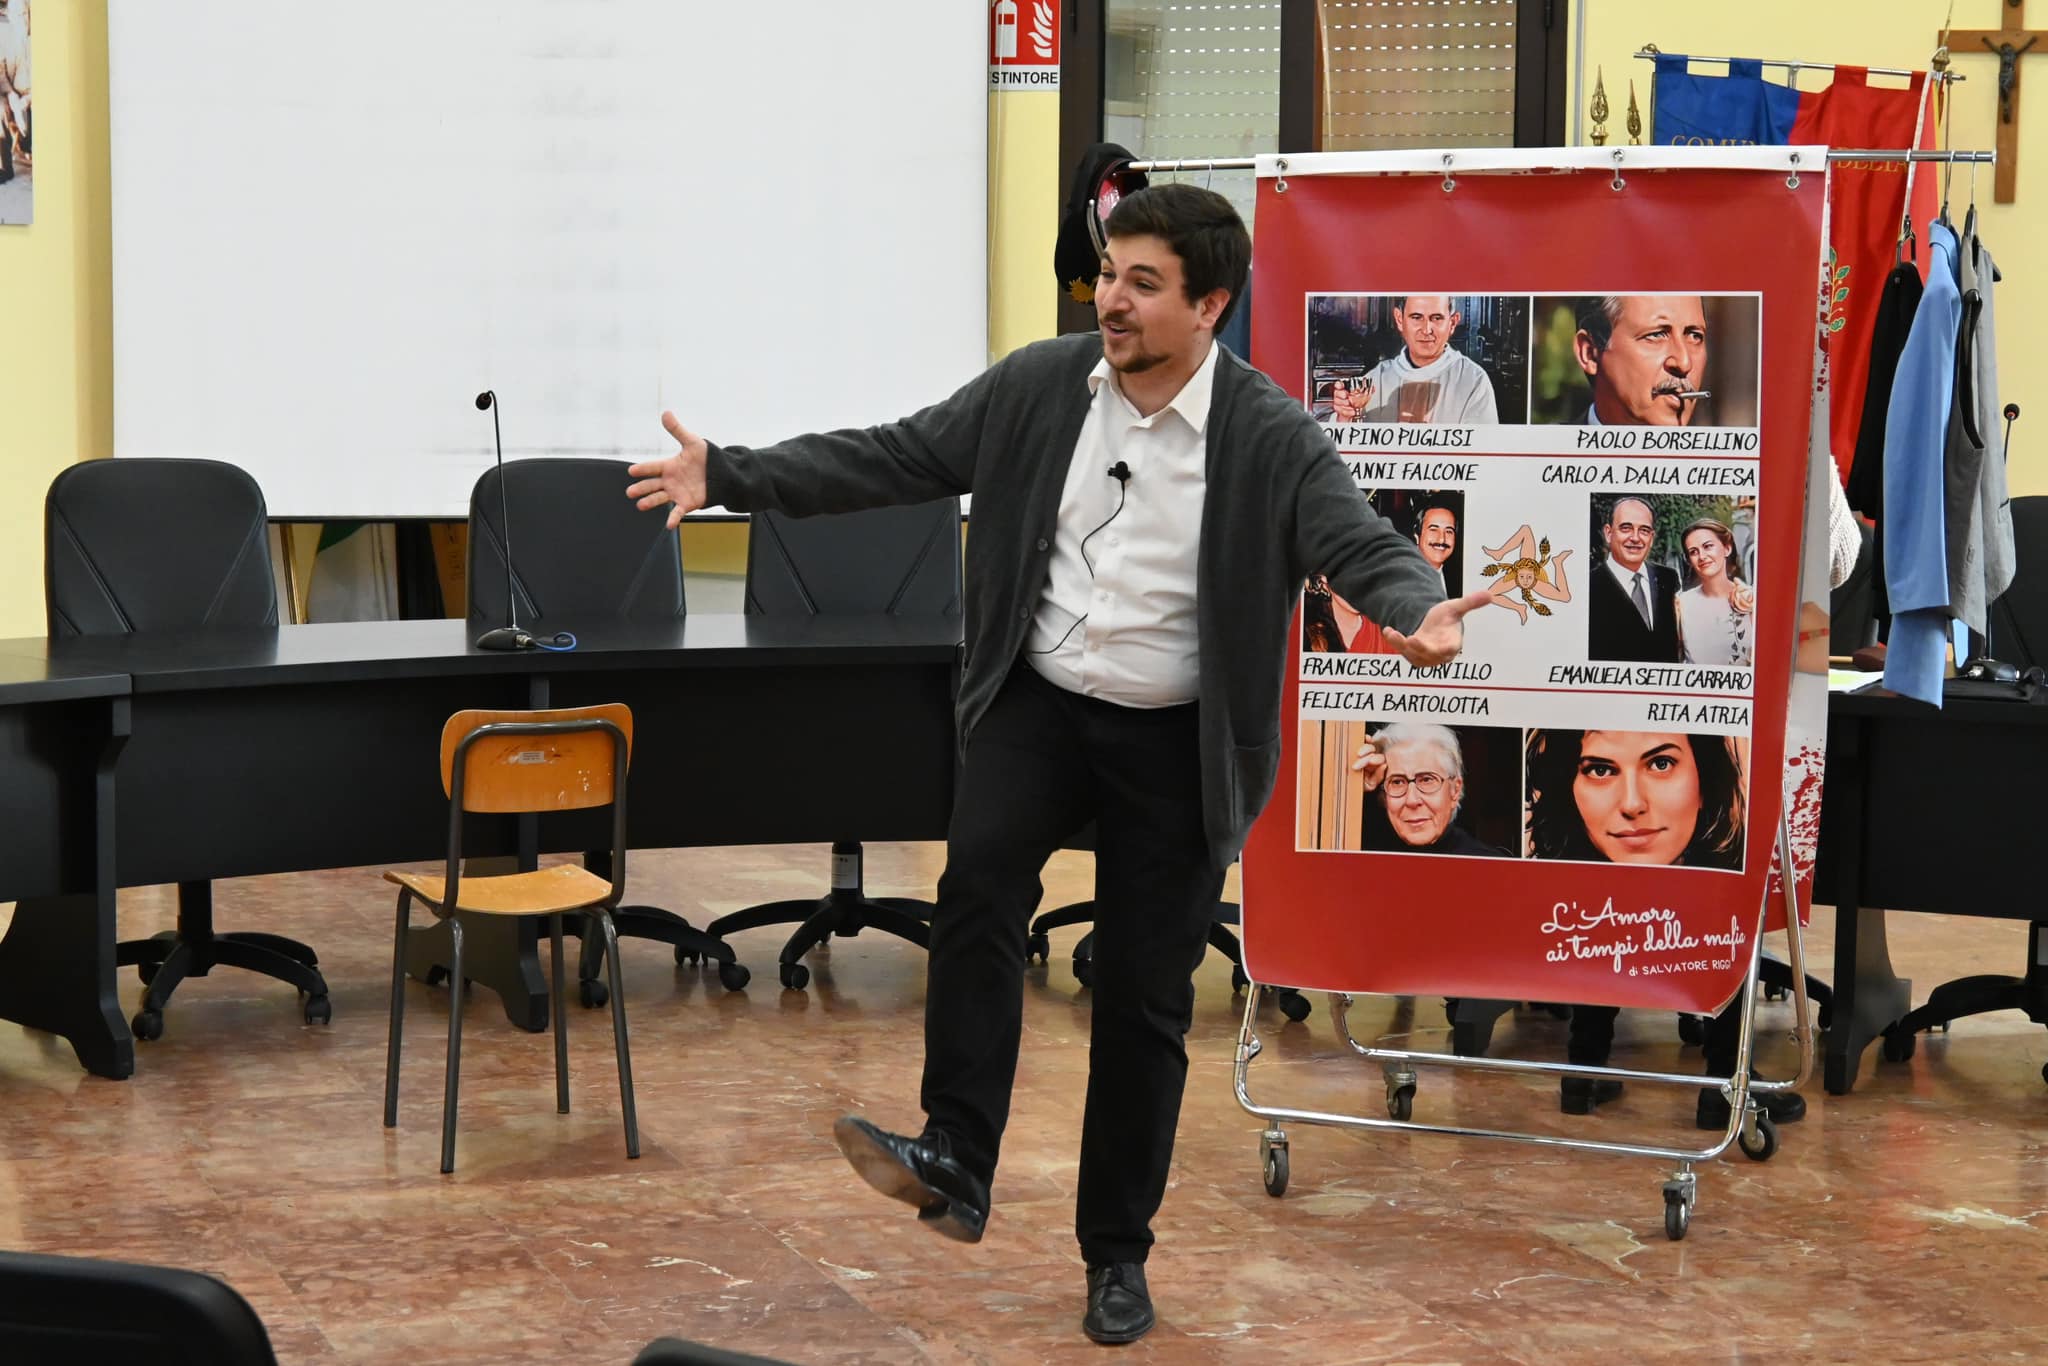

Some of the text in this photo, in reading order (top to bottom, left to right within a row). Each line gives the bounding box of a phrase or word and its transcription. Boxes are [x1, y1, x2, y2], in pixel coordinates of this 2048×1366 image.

[991, 71, 1058, 84] STINTORE
[1323, 427, 1474, 447] ON PINO PUGLISI
[1577, 429, 1758, 451] PAOLO BORSELLINO
[1347, 462, 1479, 481] ANNI FALCONE
[1542, 465, 1756, 487] CARLO A. DALLA CHIESA
[1303, 657, 1492, 681] FRANCESCA MORVILLO
[1548, 665, 1752, 690] EMANUELA SETTI CARRARO
[1302, 691, 1490, 715] FELICIA BARTOLOTTA
[1648, 703, 1749, 726] RITA ATRIA
[1540, 897, 1675, 934] L'Amore
[1546, 915, 1746, 973] ai tempi della mafia
[1628, 965, 1638, 977] di
[1642, 960, 1709, 975] SALVATORE
